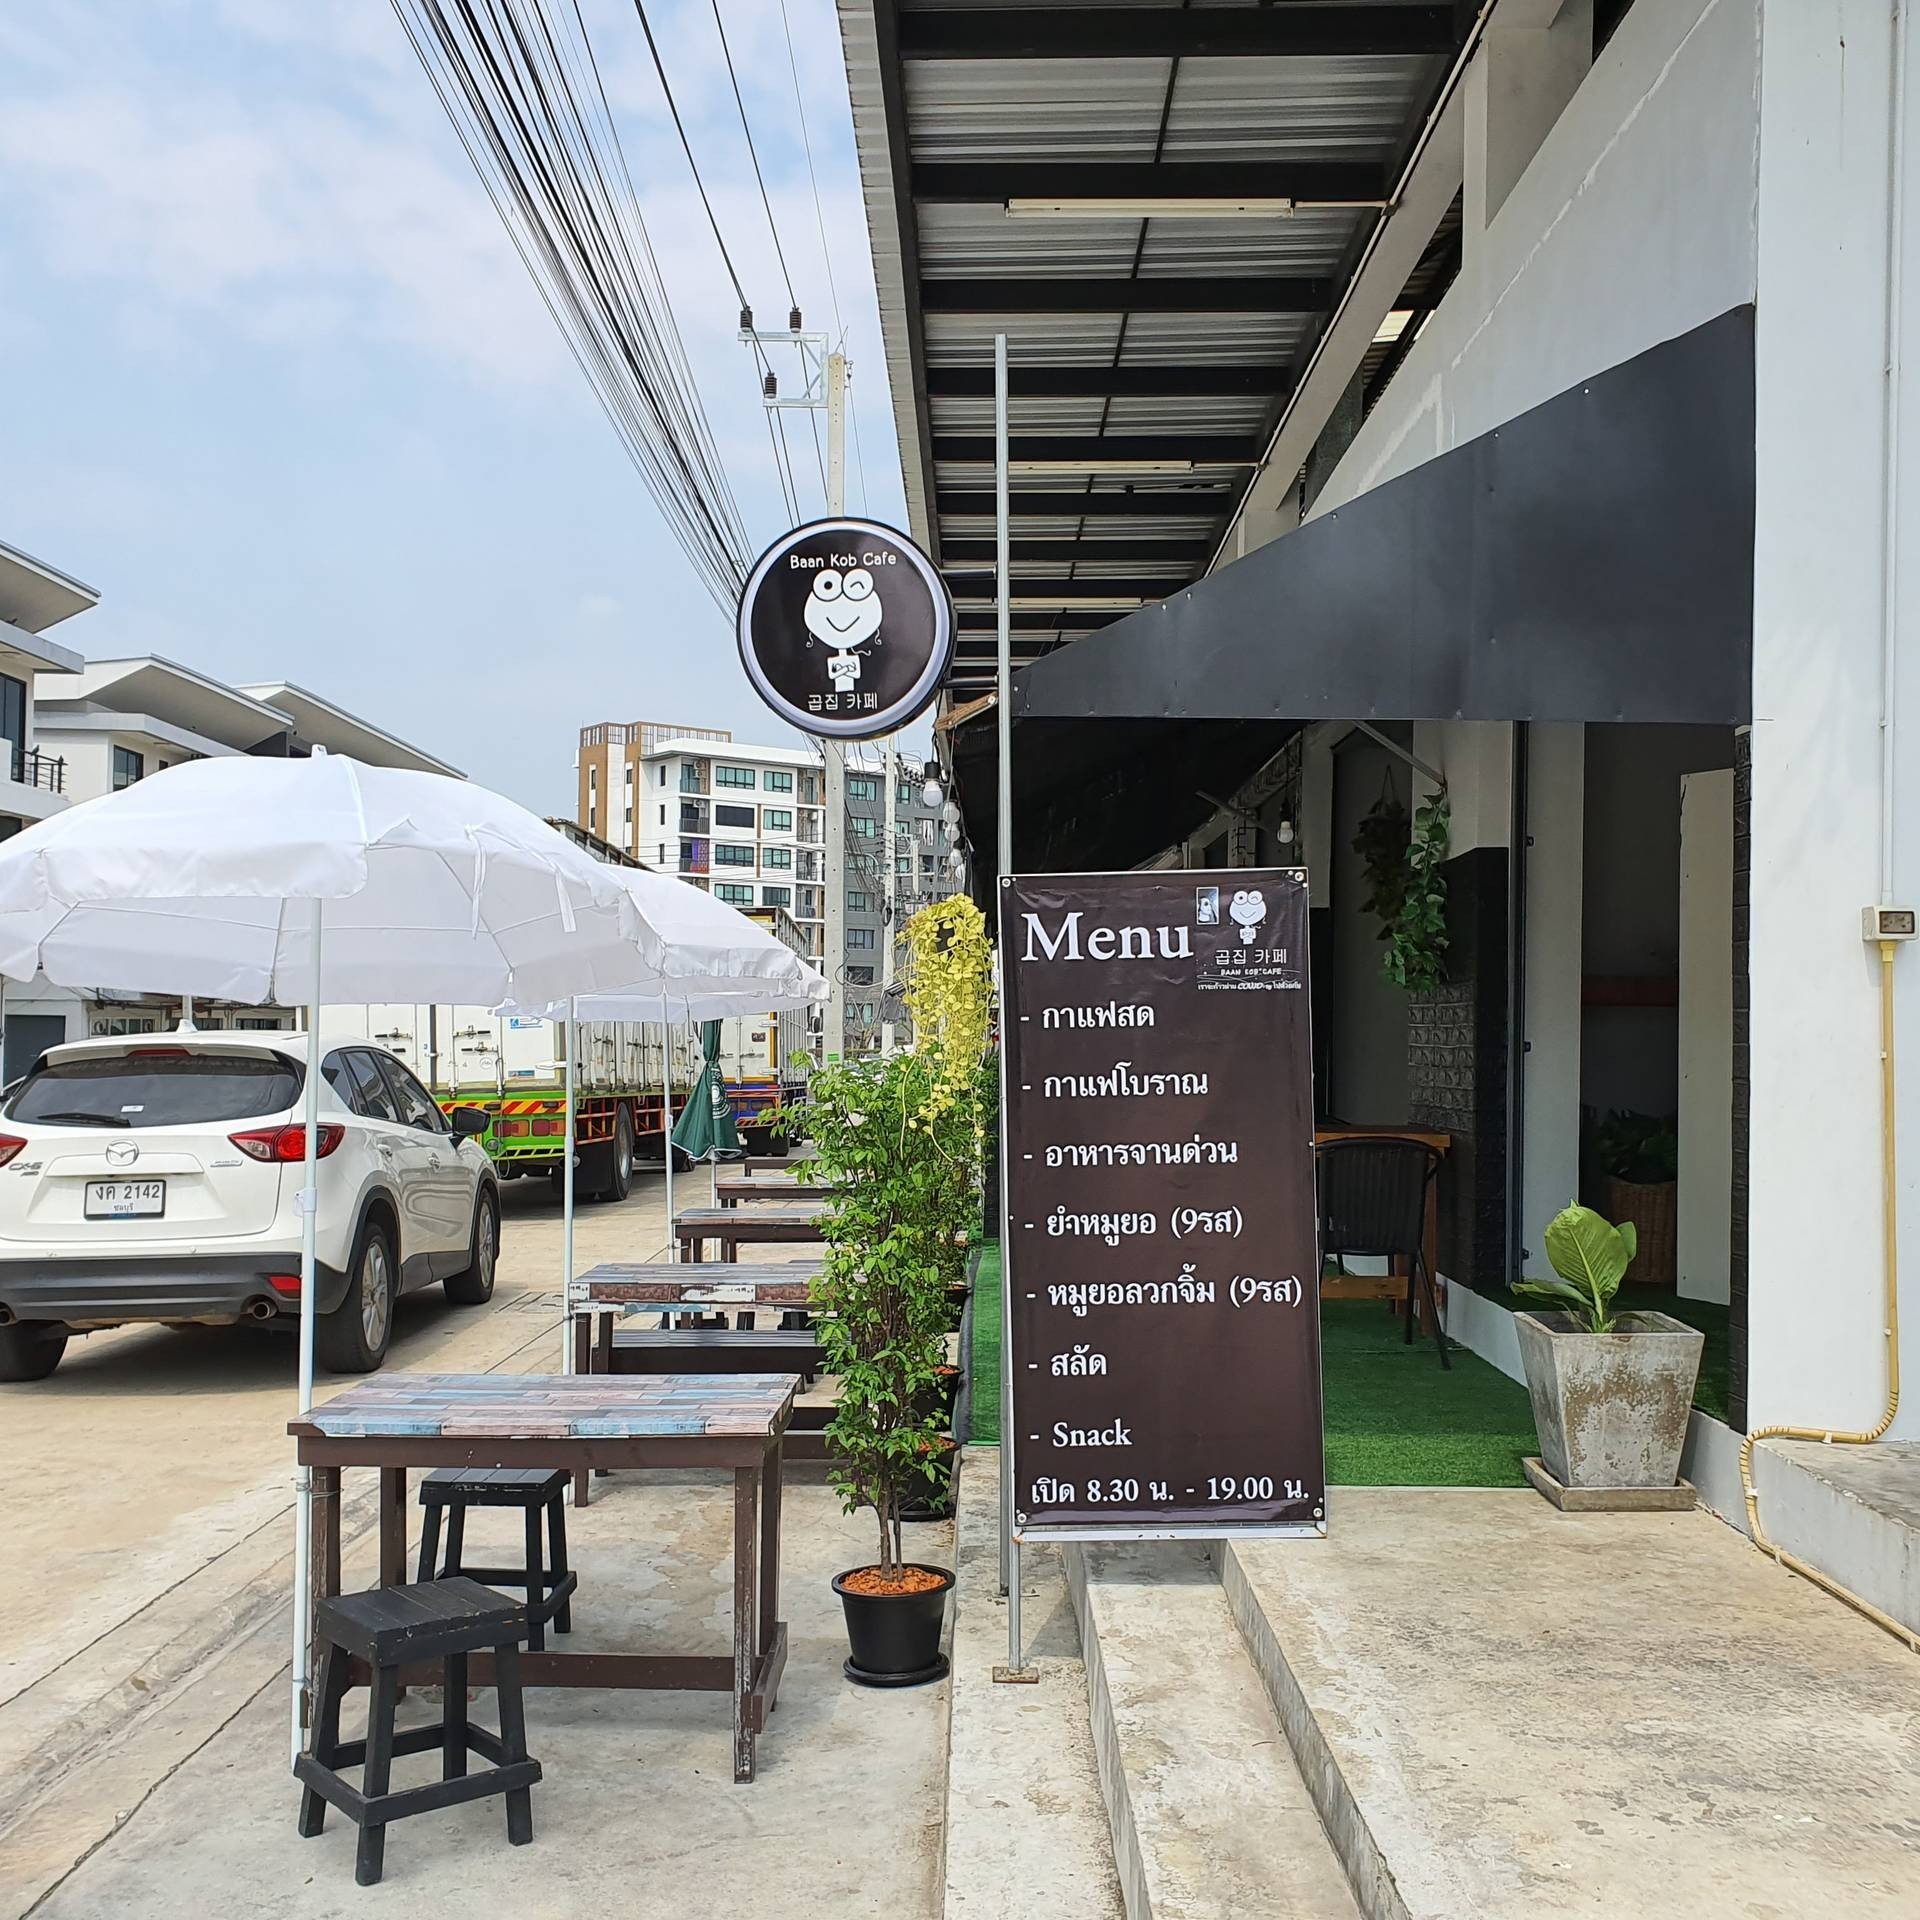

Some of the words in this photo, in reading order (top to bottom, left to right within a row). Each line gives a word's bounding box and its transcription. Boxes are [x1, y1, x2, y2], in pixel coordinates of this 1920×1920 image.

[790, 554, 825, 569] Baan
[830, 553, 857, 567] Kob
[863, 551, 897, 566] Cafe
[807, 694, 839, 711] 곱집
[846, 693, 878, 710] 카페
[1020, 911, 1195, 961] Menu
[1215, 949, 1247, 965] 곱집
[1254, 948, 1287, 964] 카페
[1220, 968, 1241, 976] BAAN
[1042, 1000, 1155, 1029] กาแฟสด
[1043, 1061, 1209, 1098] กาแฟโบราณ
[1045, 1134, 1238, 1167] อาหารจานด่วน
[96, 1186, 116, 1200] งค
[124, 1184, 160, 1199] 2142
[1047, 1205, 1157, 1247] ยำหมูยอ
[1171, 1205, 1243, 1239] (9รส)
[1047, 1263, 1215, 1317] หมูยอลวกจิ้ม
[1229, 1275, 1302, 1308] (9รส)
[1050, 1344, 1107, 1377] สลัด
[1052, 1417, 1133, 1448] Snack
[1031, 1476, 1075, 1504] เปิด
[1087, 1478, 1139, 1503] 8.30
[1148, 1481, 1174, 1501] น.
[1207, 1476, 1274, 1501] 19.00
[1283, 1479, 1309, 1499] น.
